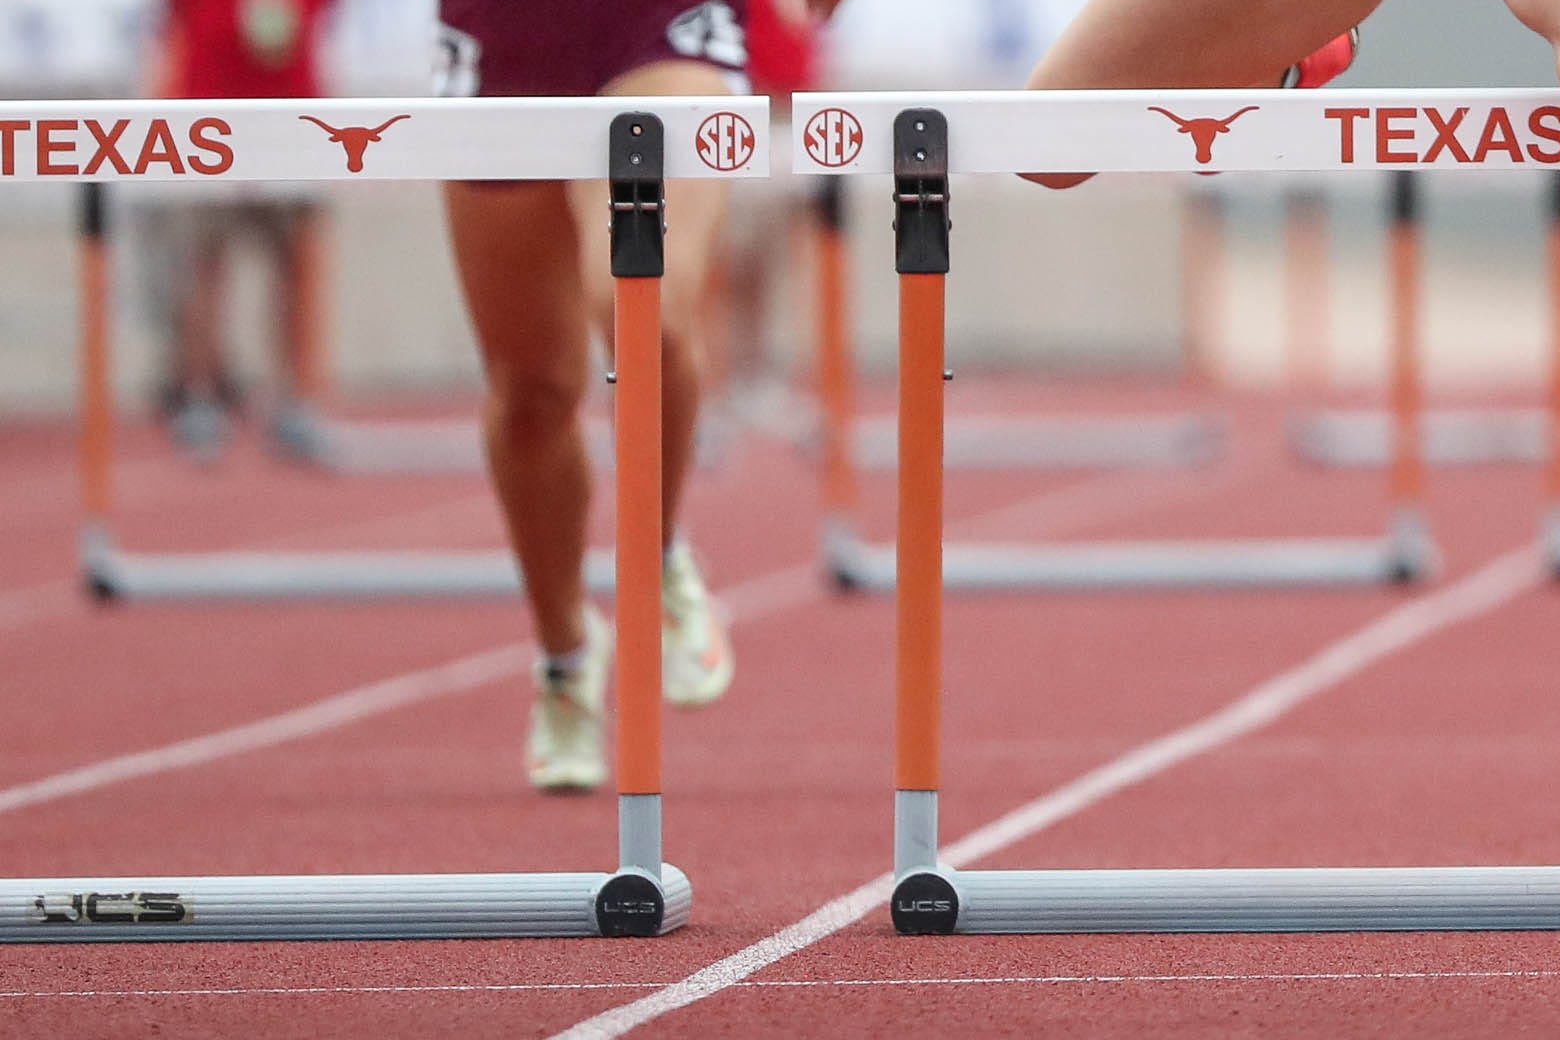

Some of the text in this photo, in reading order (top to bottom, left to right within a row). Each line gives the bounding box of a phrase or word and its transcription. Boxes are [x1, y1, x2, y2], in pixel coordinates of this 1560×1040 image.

[0, 117, 235, 176] TEXAS
[699, 114, 752, 169] SEC
[806, 111, 861, 164] SEC
[898, 900, 951, 912] UCS
